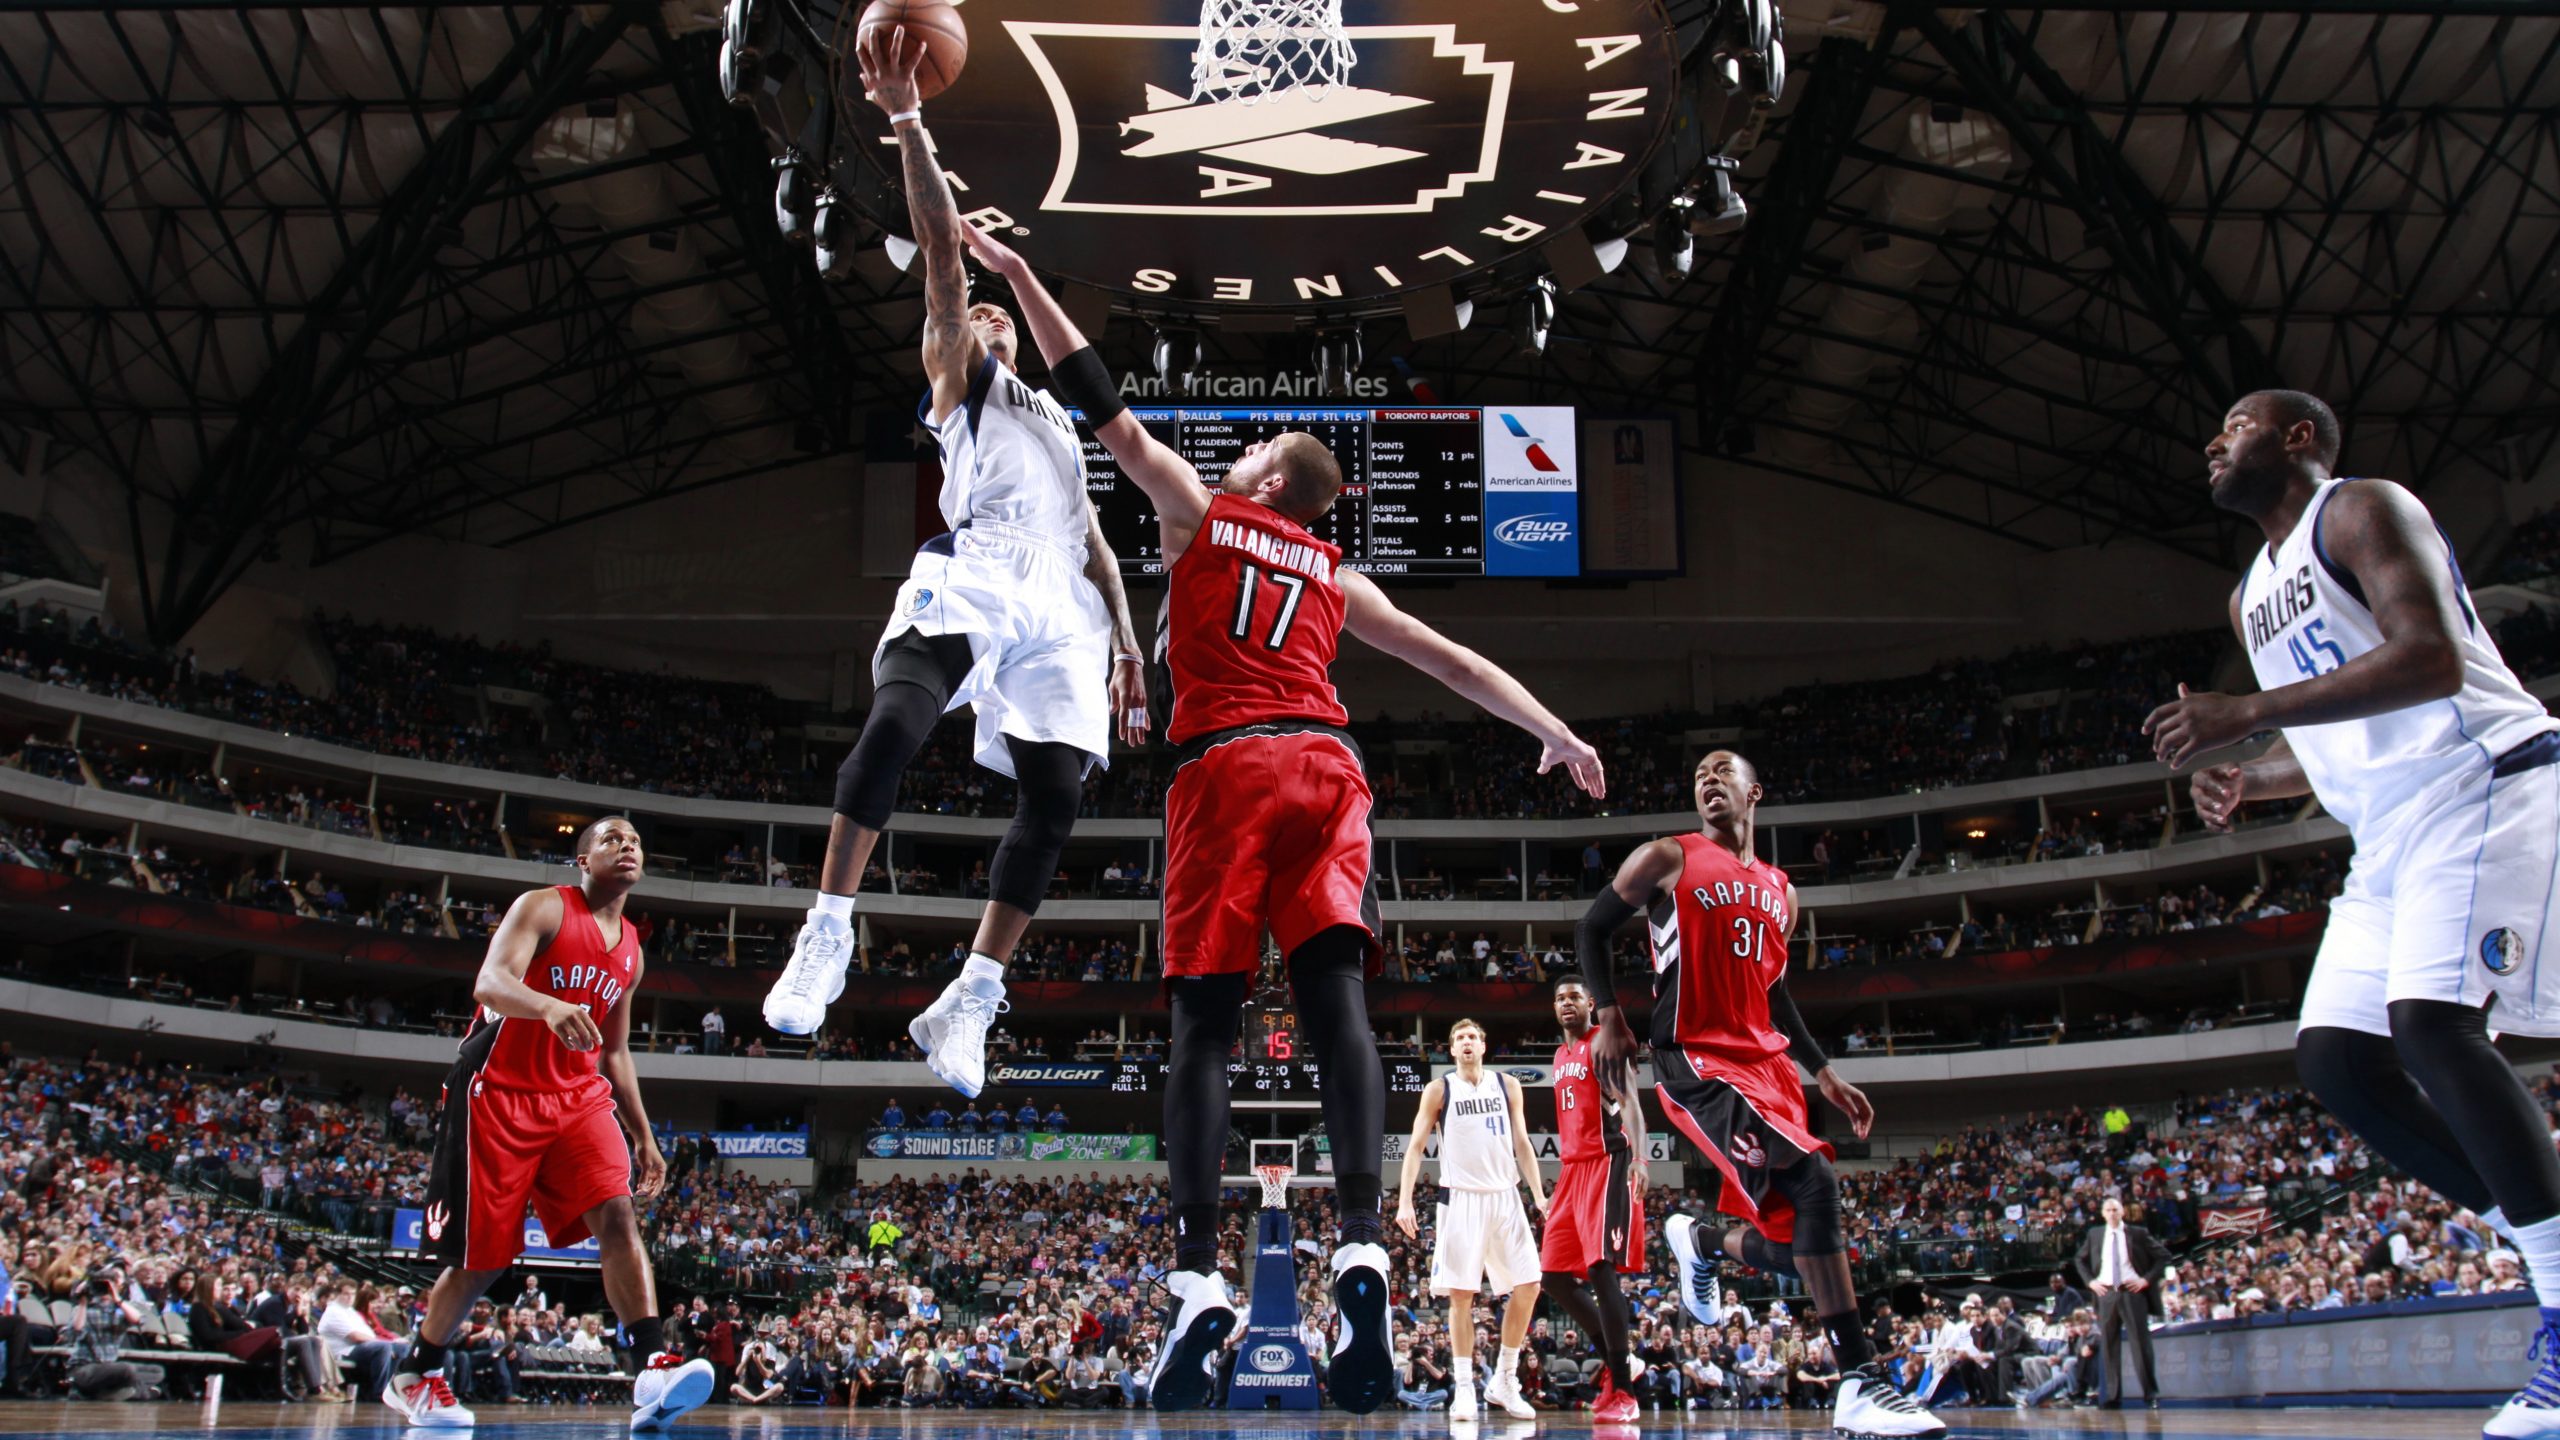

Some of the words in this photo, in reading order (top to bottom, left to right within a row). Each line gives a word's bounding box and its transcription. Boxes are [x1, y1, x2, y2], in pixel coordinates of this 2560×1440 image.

[1199, 165, 1272, 198] A
[1118, 371, 1265, 397] Amrican
[1271, 371, 1388, 397] Airles
[1005, 378, 1076, 434] DALL
[1134, 413, 1169, 421] ERICKS
[1183, 412, 1222, 421] DALLAS
[1250, 413, 1268, 421] PTS
[1274, 413, 1292, 421] REB
[1298, 413, 1317, 421] AST
[1323, 413, 1340, 421] STL
[1345, 413, 1361, 421] FLS
[1385, 412, 1428, 420] TORONTO
[1430, 412, 1470, 420] RAPTORS
[1085, 452, 1115, 461] witzki
[1372, 452, 1404, 463] Lowry
[1441, 452, 1454, 460] 12
[1461, 453, 1475, 461] pts
[1372, 481, 1415, 490] Johnson
[1444, 481, 1451, 490] 5
[1490, 477, 1535, 486] American
[1536, 477, 1572, 486] Airlines
[1346, 488, 1363, 496] FLS
[1139, 515, 1146, 524] 7
[1372, 514, 1418, 523] DeRozan
[1445, 514, 1452, 523] 5
[1515, 521, 1568, 531] BUD
[1504, 531, 1572, 541] LIGHT
[1140, 547, 1147, 555] 2
[1211, 519, 1330, 585] VALANCIUNAS
[1372, 546, 1416, 555] Johnson
[1445, 547, 1452, 555] 2
[1143, 564, 1162, 572] GET
[1340, 564, 1407, 573] GEAR.COM!
[1231, 561, 1306, 651] 17
[2248, 565, 2314, 656] DALLAS
[2288, 617, 2346, 677] 45
[1693, 881, 1788, 933] RAPTORS
[1733, 917, 1765, 961] 31
[550, 964, 622, 1009] RAPTOR
[1263, 1015, 1294, 1028] 9:19
[1268, 1031, 1291, 1058] 15
[997, 1068, 1042, 1080] BUD
[1042, 1069, 1105, 1080] LIGHT
[1256, 1066, 1288, 1076] 9:0
[1283, 1080, 1291, 1089] 3
[1406, 1075, 1420, 1083] :20
[1112, 1084, 1132, 1092] FULL
[1140, 1084, 1147, 1092] 4
[1561, 1086, 1575, 1111] 15
[1455, 1097, 1502, 1116] DALLAS
[1485, 1116, 1505, 1136] 41
[1065, 1135, 1097, 1147] SLAM
[1101, 1136, 1132, 1147] DUNK
[1384, 1136, 1400, 1144] ICA
[904, 1137, 951, 1155] SOUND
[953, 1138, 995, 1156] STAGE
[1651, 1143, 1663, 1159] 6
[1067, 1147, 1107, 1160] ZONE
[1260, 1351, 1284, 1361] FOX
[1235, 1374, 1311, 1386] SOUTHWEST
